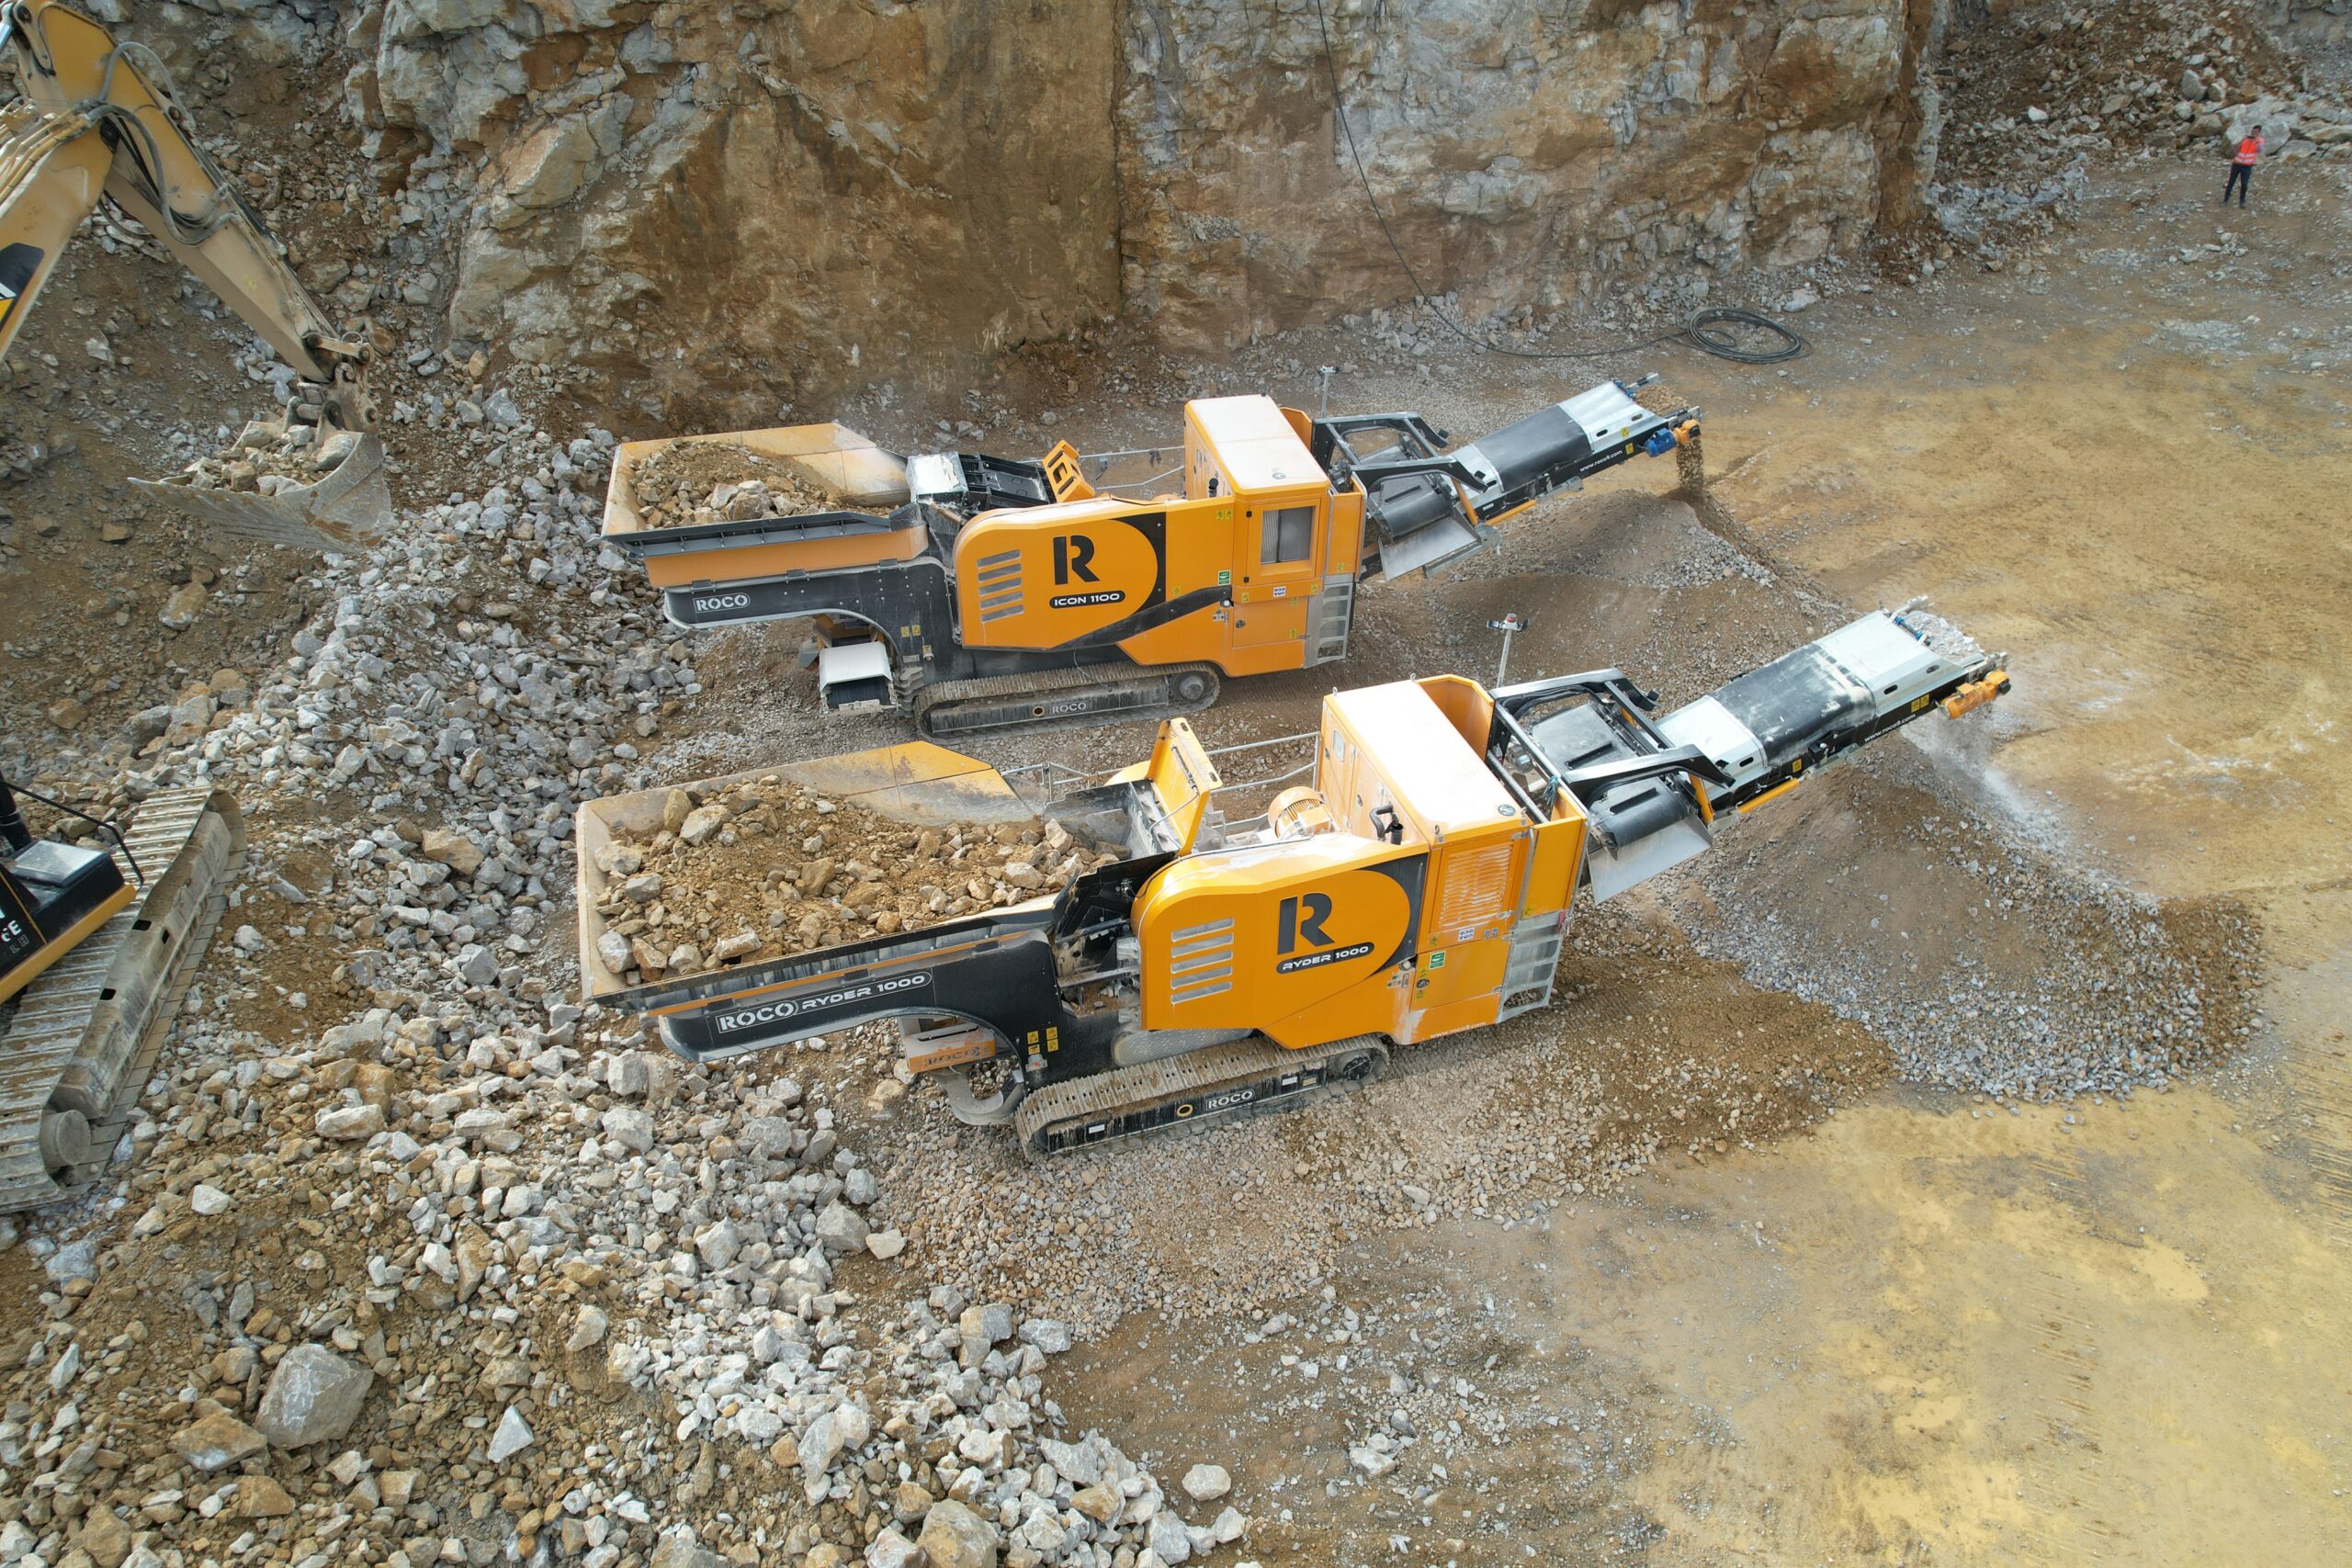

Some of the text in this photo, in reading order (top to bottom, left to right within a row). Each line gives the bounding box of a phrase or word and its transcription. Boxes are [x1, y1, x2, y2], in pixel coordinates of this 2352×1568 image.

[1053, 535, 1101, 585] R
[696, 594, 748, 612] ROCO
[1055, 593, 1120, 606] ICON 1100
[1052, 702, 1087, 714] ROCO
[1277, 893, 1336, 955] R
[1283, 945, 1369, 971] RYDER 1000
[719, 975, 925, 1031] ROCO RYDER 1000
[1208, 1090, 1253, 1109] ROCO
